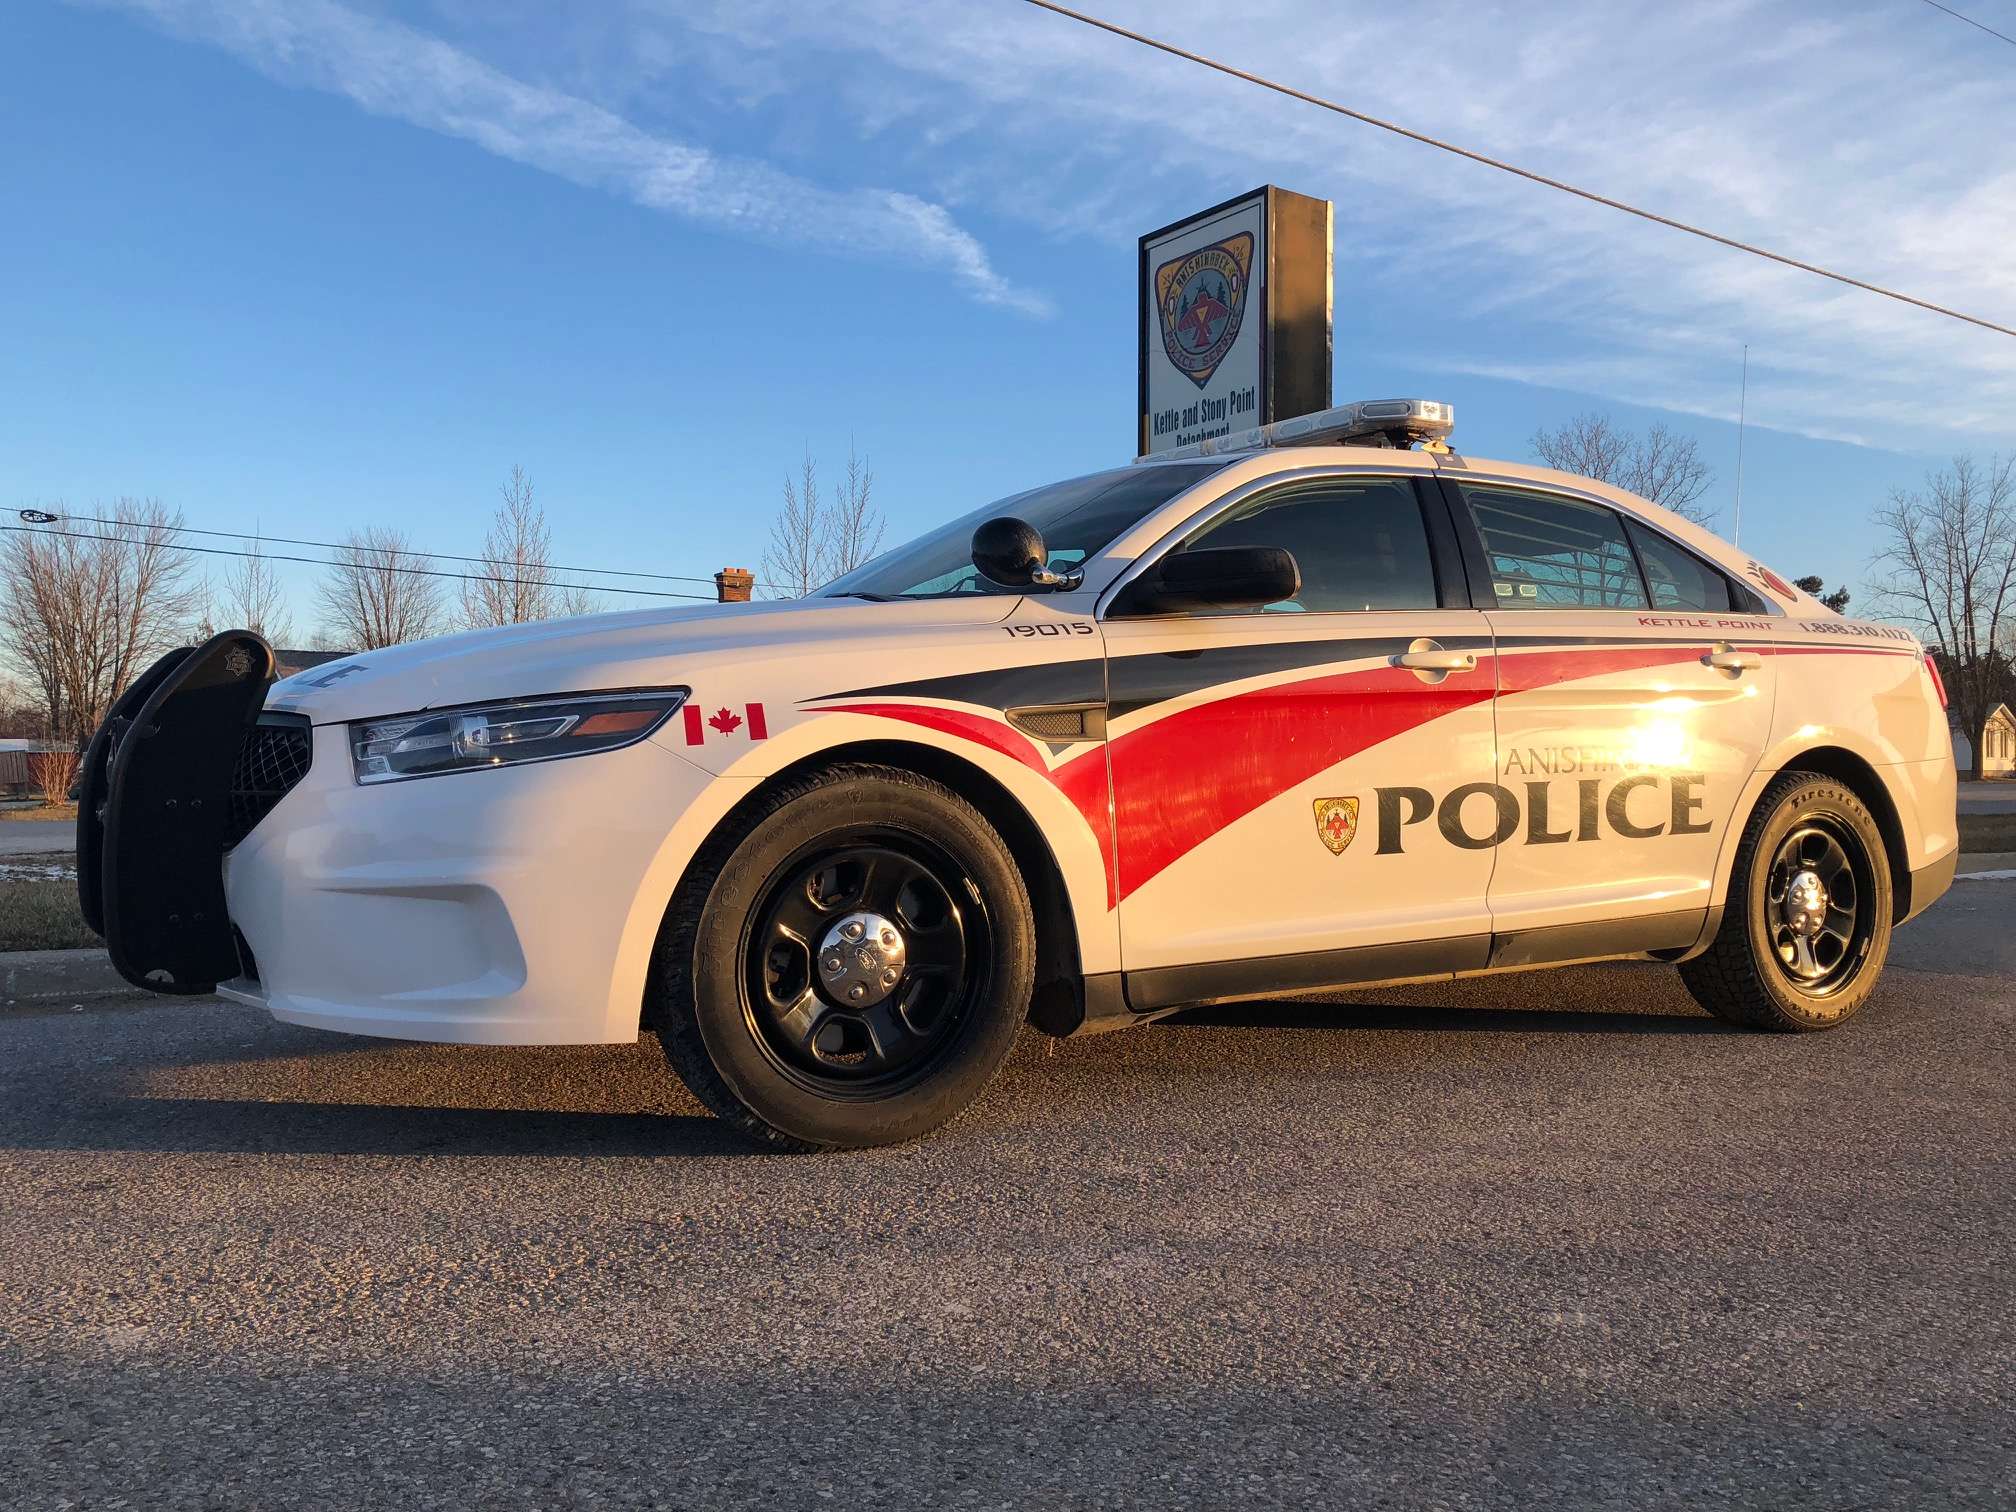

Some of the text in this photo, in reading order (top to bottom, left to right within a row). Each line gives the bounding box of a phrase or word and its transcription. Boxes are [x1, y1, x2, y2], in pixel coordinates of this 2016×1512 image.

[1154, 386, 1255, 436] Kettle and Stony Point
[1001, 622, 1093, 638] 19015
[1637, 617, 1773, 630] KETTLE POINT
[1373, 775, 1713, 855] POLICE
[1791, 789, 1871, 826] Firestone
